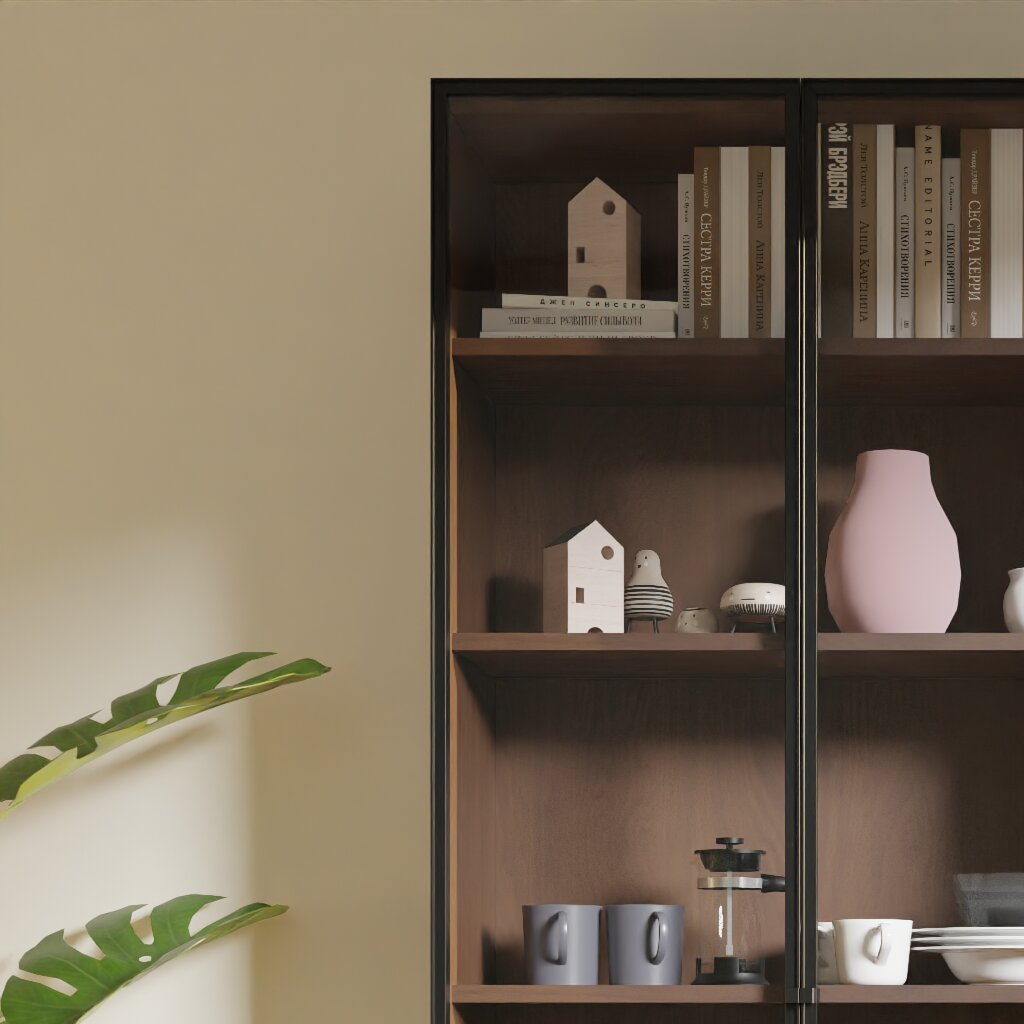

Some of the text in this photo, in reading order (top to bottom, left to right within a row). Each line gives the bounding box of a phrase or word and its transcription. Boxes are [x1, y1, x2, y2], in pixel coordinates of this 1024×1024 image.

[827, 148, 848, 208] БРЭДБЕРИ
[700, 213, 712, 307] СЕСТРА КЕРРИ
[900, 215, 909, 298] СТИХОТВОРЕНИЯ
[924, 177, 933, 267] EDITORIAL
[968, 200, 981, 301] СЕСТРА КЕРРИ
[682, 234, 690, 309] СТИХОТВОРЕНИЯ
[946, 223, 955, 304] СТИХОТВОРЕНИЯ
[586, 301, 646, 309] СИНСЕРО
